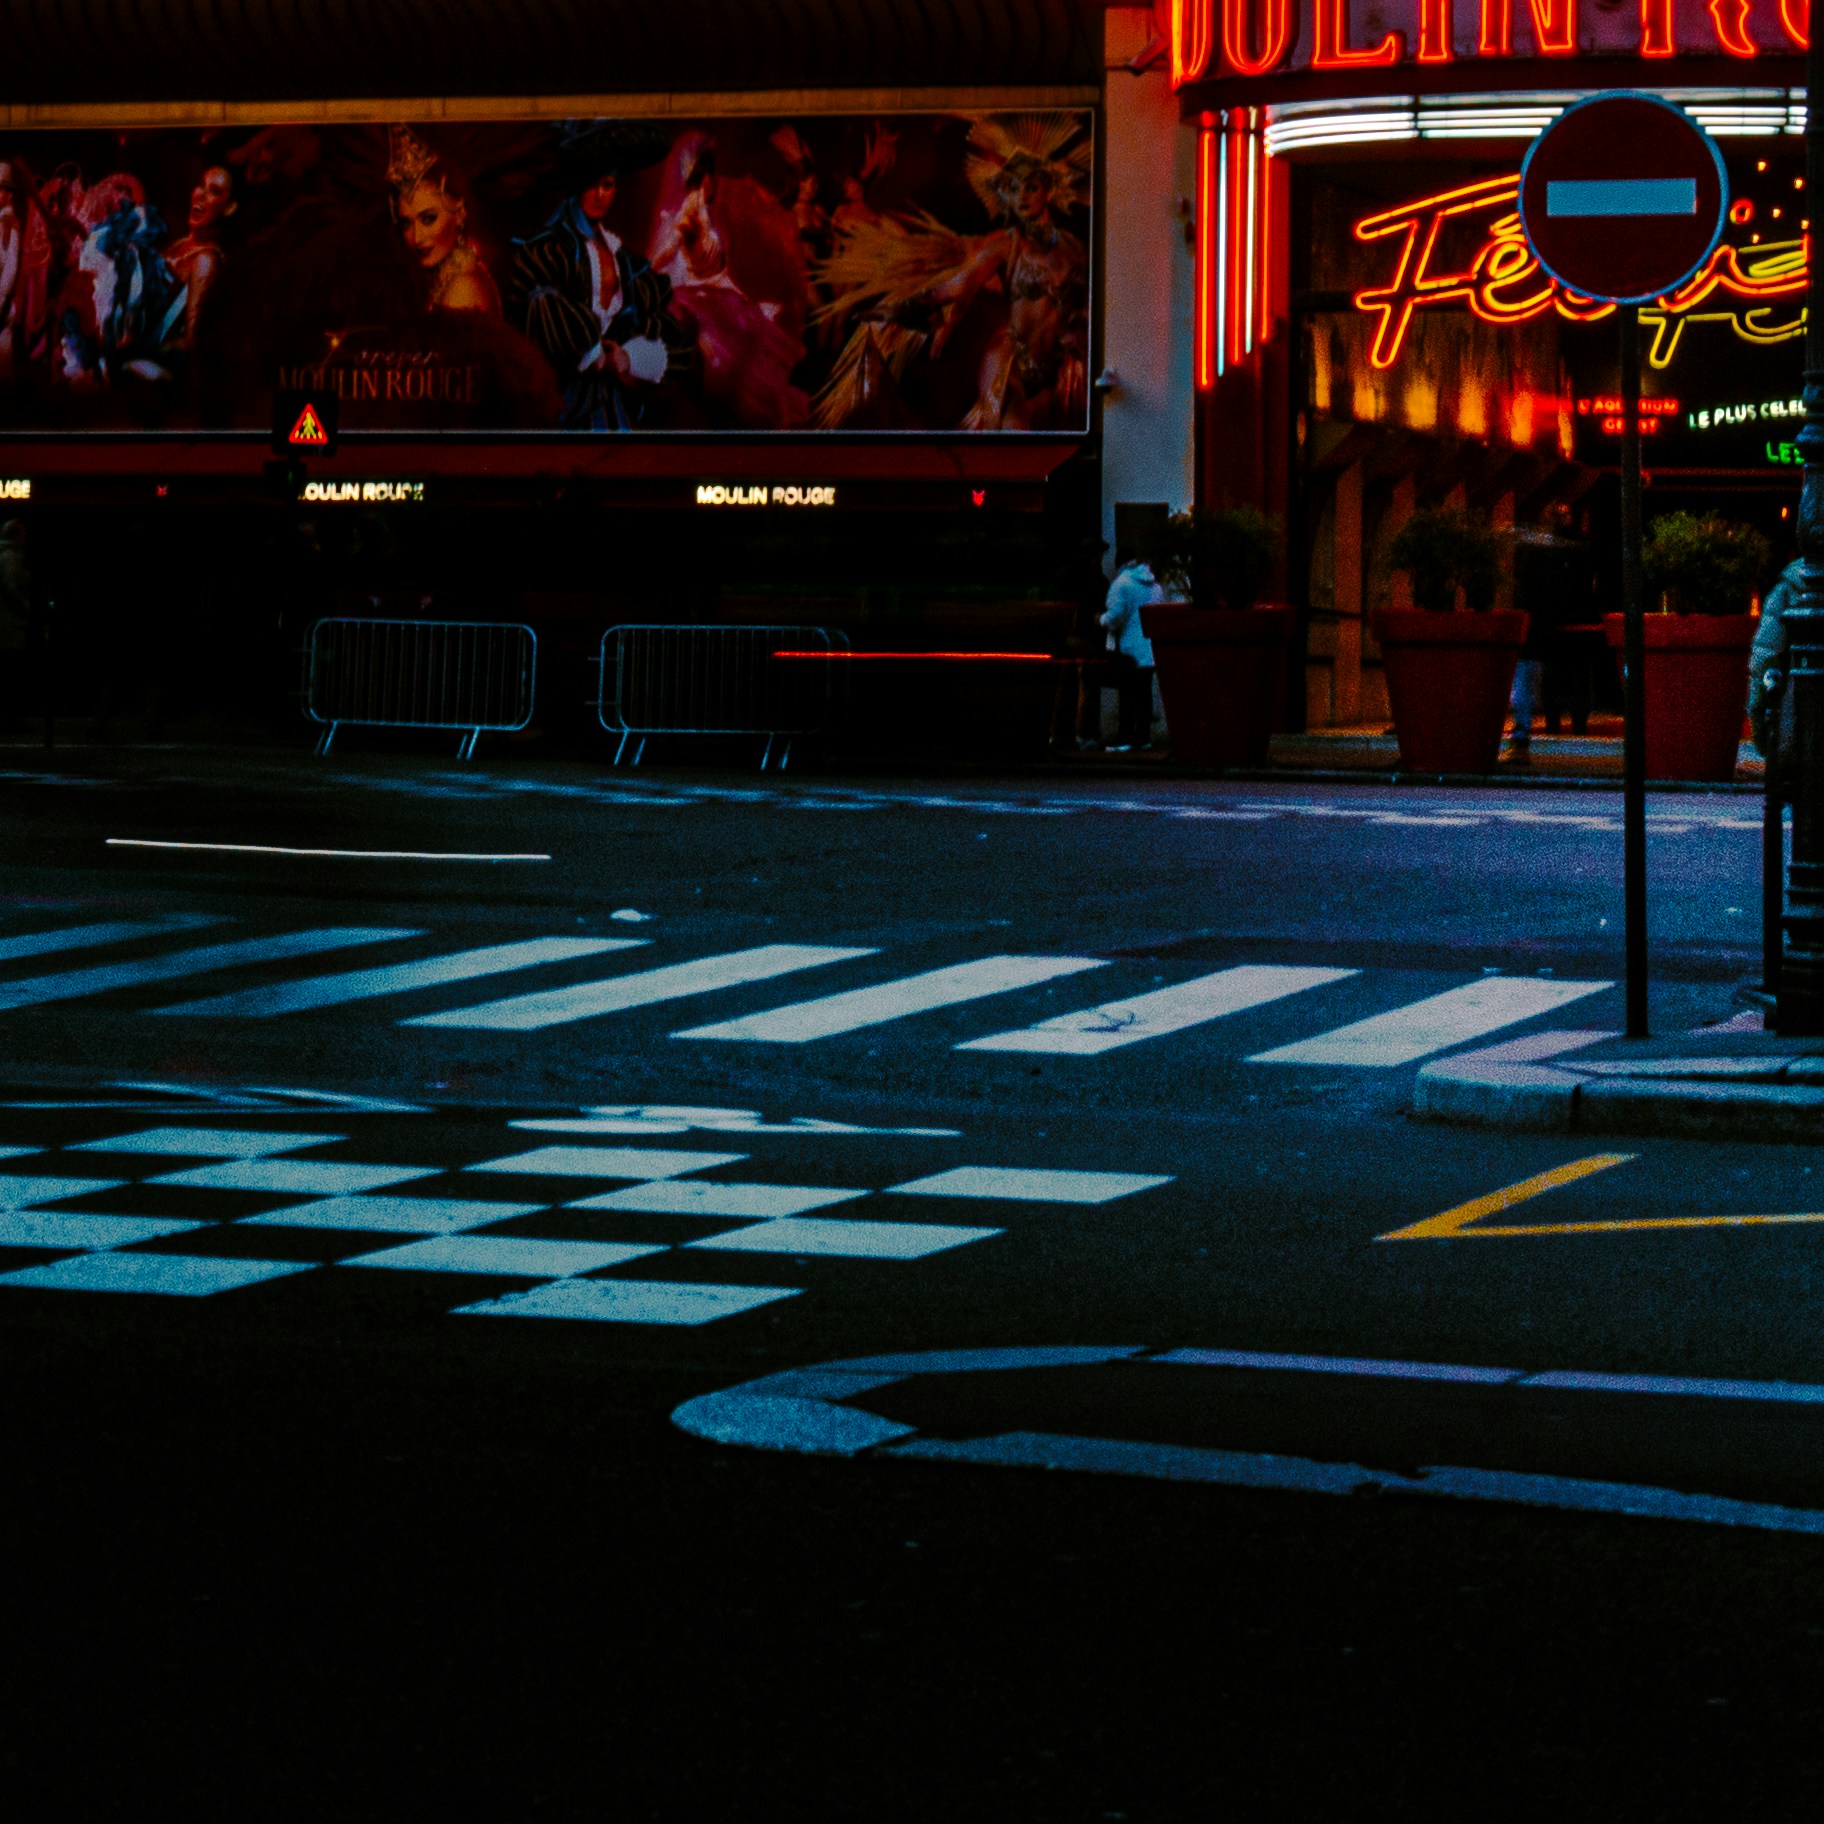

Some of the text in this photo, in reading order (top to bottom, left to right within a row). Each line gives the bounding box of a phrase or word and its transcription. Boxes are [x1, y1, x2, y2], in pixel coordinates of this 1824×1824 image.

[1688, 410, 1711, 429] LE
[1713, 403, 1757, 425] PLUS
[298, 481, 360, 501] OULIN
[696, 485, 836, 506] MOULIN ROUGE
